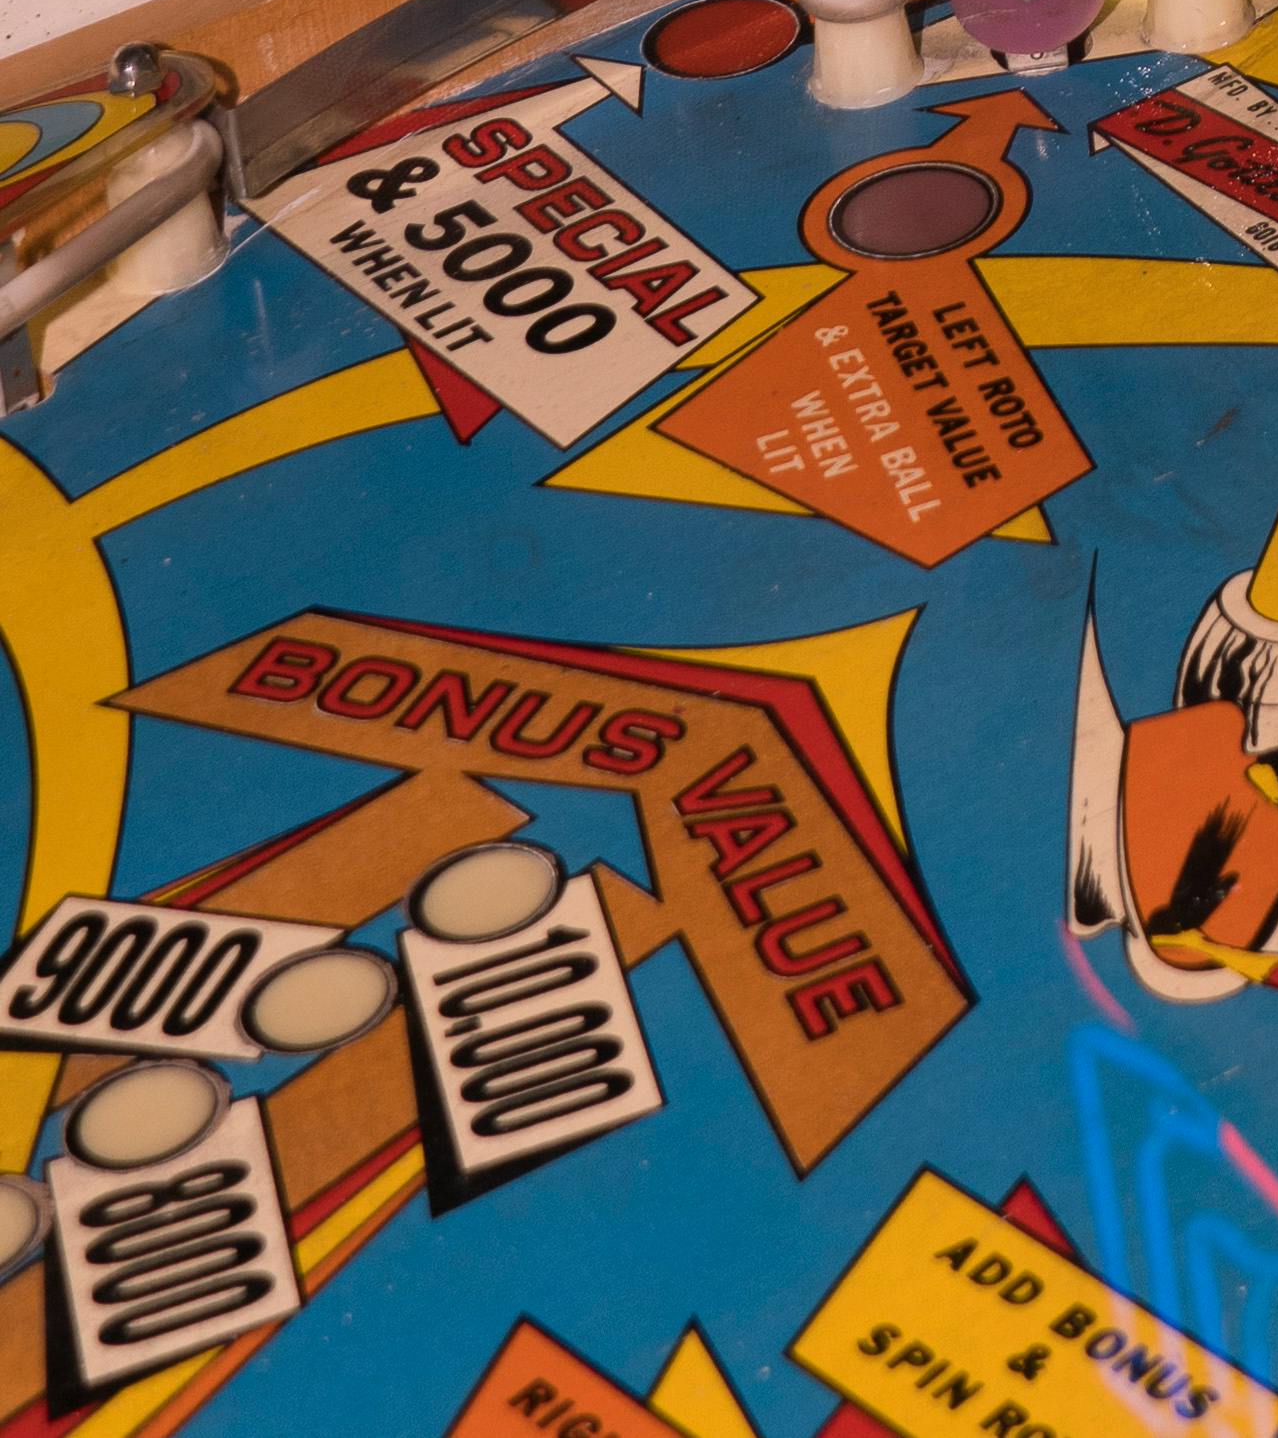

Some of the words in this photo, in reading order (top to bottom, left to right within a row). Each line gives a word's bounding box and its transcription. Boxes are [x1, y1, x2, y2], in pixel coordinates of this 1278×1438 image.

[329, 219, 441, 309] WHEN
[414, 300, 495, 352] LIT
[346, 154, 440, 215] &
[404, 199, 619, 356] 5000
[441, 115, 731, 348] SPECIAL
[814, 324, 849, 349] &
[828, 347, 901, 443] EXTRA
[866, 290, 950, 391] TARGET
[926, 395, 1003, 489] VALUE
[932, 301, 1000, 369] LEFT
[978, 375, 1044, 450] ROTO
[756, 428, 806, 474] LIT
[790, 390, 859, 480] WHEN
[880, 445, 942, 524] BALL
[227, 637, 689, 776] BONUS
[672, 746, 903, 1041] VALUE
[8, 909, 261, 1037] 9000
[431, 924, 635, 1139] 10,000
[77, 1158, 277, 1346] 8000
[856, 1320, 986, 1411] SPIN
[934, 1235, 1045, 1306] ADD
[1049, 1301, 1218, 1421] BONUS
[1006, 1341, 1053, 1381] &
